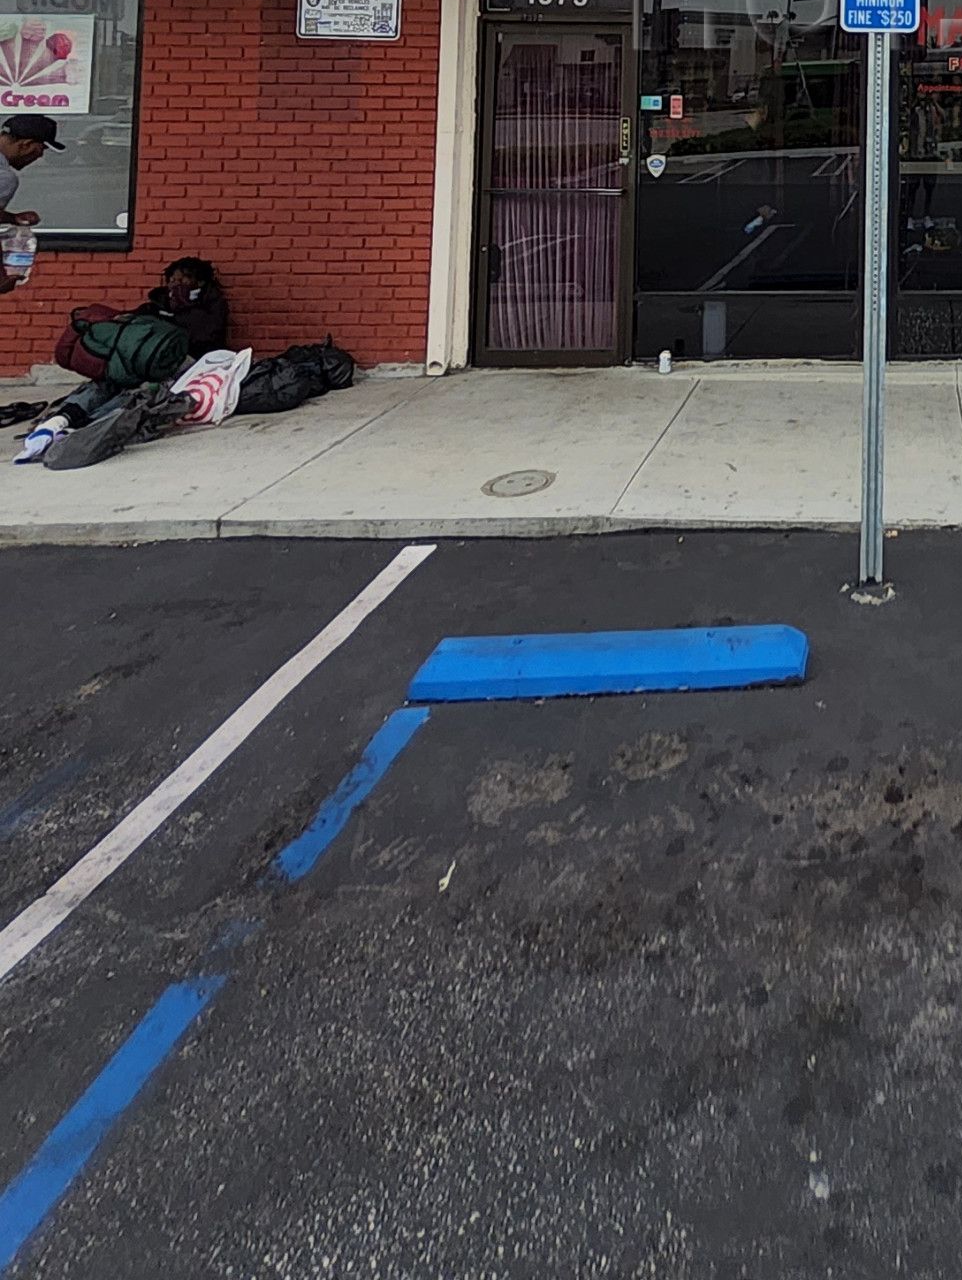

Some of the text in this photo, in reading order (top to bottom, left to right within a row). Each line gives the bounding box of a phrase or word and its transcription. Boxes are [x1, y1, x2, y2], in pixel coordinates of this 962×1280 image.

[848, 9, 912, 26] FINE $250
[1, 90, 70, 107] Cream
